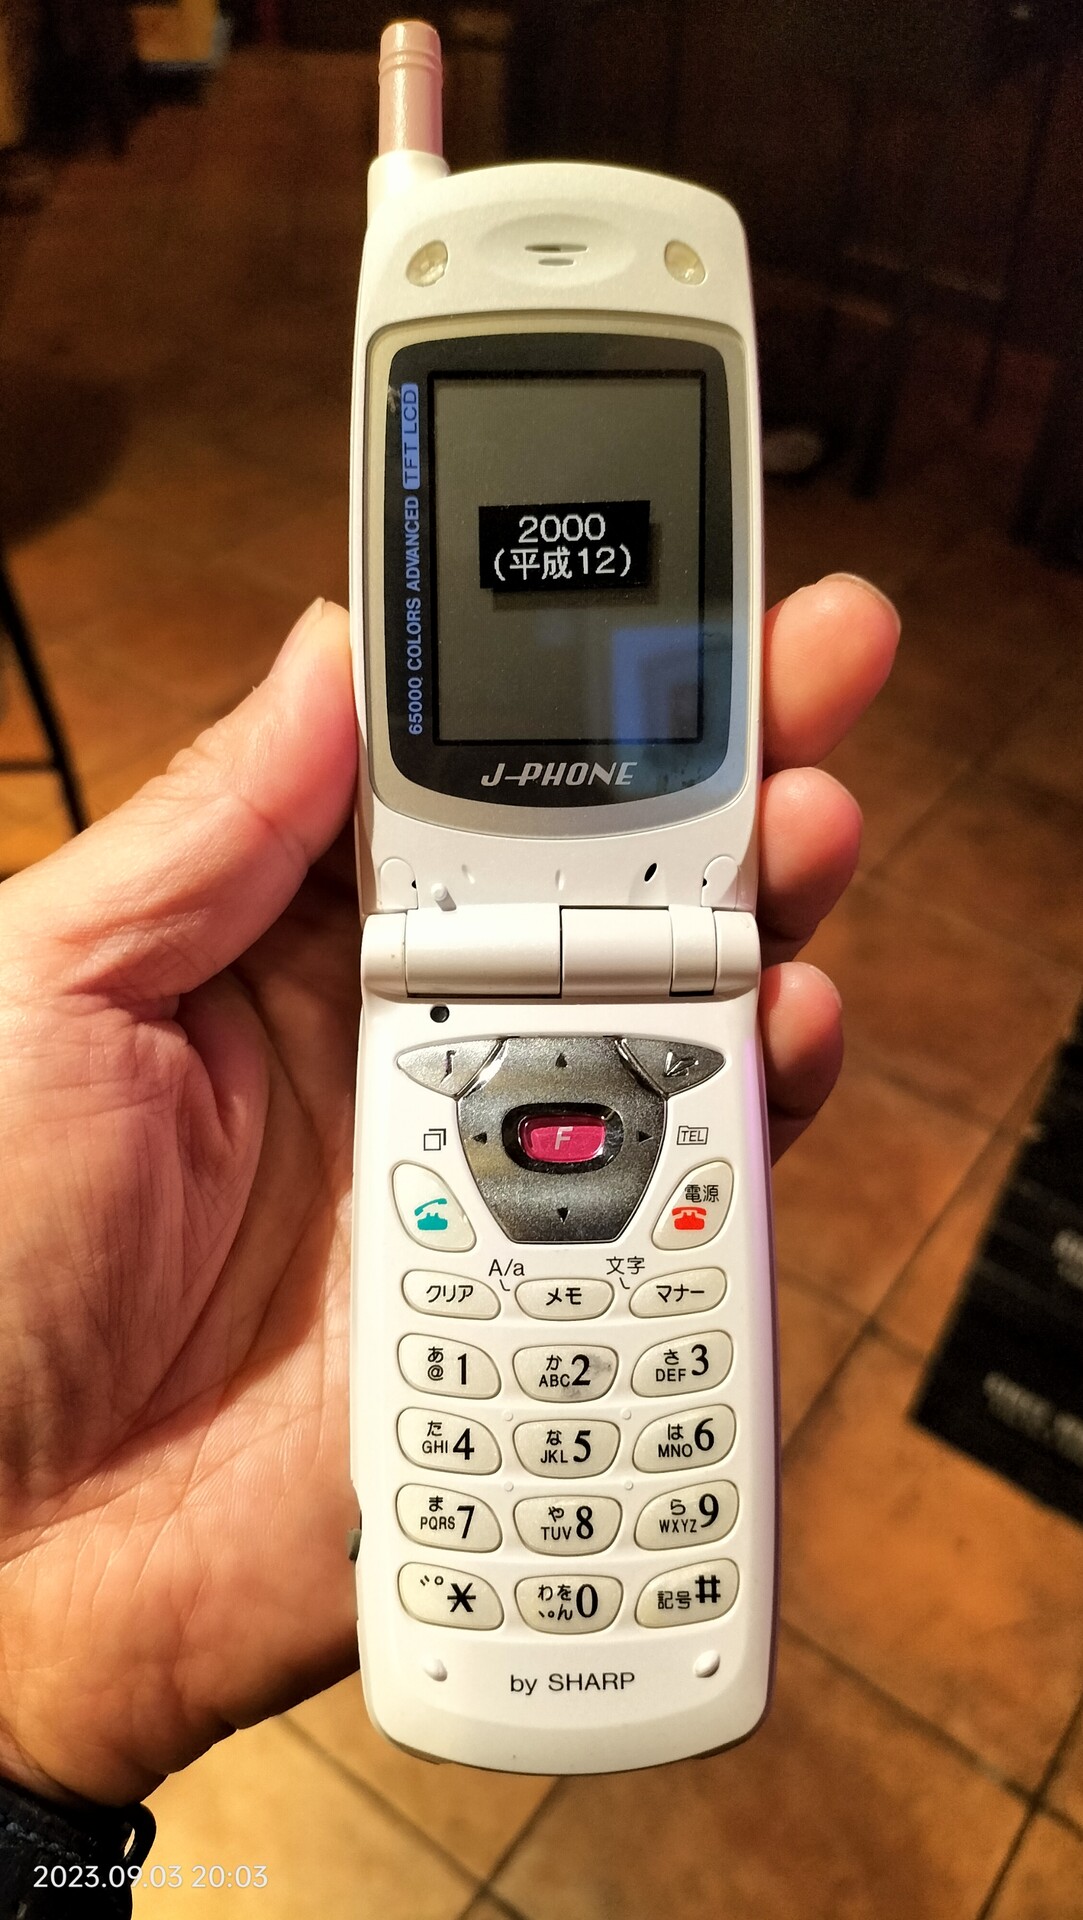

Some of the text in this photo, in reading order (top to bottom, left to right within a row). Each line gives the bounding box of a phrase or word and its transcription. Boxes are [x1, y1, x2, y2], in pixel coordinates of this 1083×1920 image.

[518, 513, 606, 543] 2000
[403, 388, 423, 735] 65000 COLORS ADVANCED TFT LCD
[493, 544, 632, 581] (平成12)
[480, 762, 638, 786] J-PHONE
[554, 1126, 573, 1150] F
[681, 1131, 704, 1143] TEL
[685, 1184, 719, 1204] 電源
[489, 1259, 525, 1278] A/a
[606, 1256, 645, 1276] 文字
[426, 1284, 474, 1303] クリア
[546, 1287, 582, 1306] メモ
[656, 1284, 705, 1303] マナー
[428, 1347, 444, 1363] あ
[546, 1354, 562, 1371] か
[663, 1349, 680, 1366] さ
[691, 1344, 708, 1376] 3
[428, 1365, 443, 1381] @
[458, 1353, 467, 1385] 1
[571, 1354, 591, 1386] 2
[655, 1368, 686, 1382] DEF
[539, 1374, 570, 1388] ABC
[427, 1420, 443, 1437] た
[546, 1429, 562, 1446] な
[667, 1423, 684, 1440] は
[694, 1418, 715, 1451] 6
[422, 1440, 448, 1454] GHI
[453, 1428, 475, 1460] 4
[573, 1430, 591, 1463] 5
[658, 1444, 692, 1458] MNO
[540, 1449, 568, 1464] JKL
[428, 1496, 443, 1512] ま
[670, 1498, 686, 1516] ら
[698, 1493, 719, 1528] 9
[420, 1516, 455, 1531] PQRS
[457, 1505, 475, 1539] 7
[548, 1506, 564, 1522] や
[576, 1506, 594, 1539] 8
[541, 1527, 572, 1541] TUV
[659, 1519, 697, 1533] WXYZ
[695, 1574, 721, 1604] #
[576, 1583, 598, 1618] 0
[658, 1590, 692, 1610] 記号
[510, 1672, 635, 1695] by SHARP
